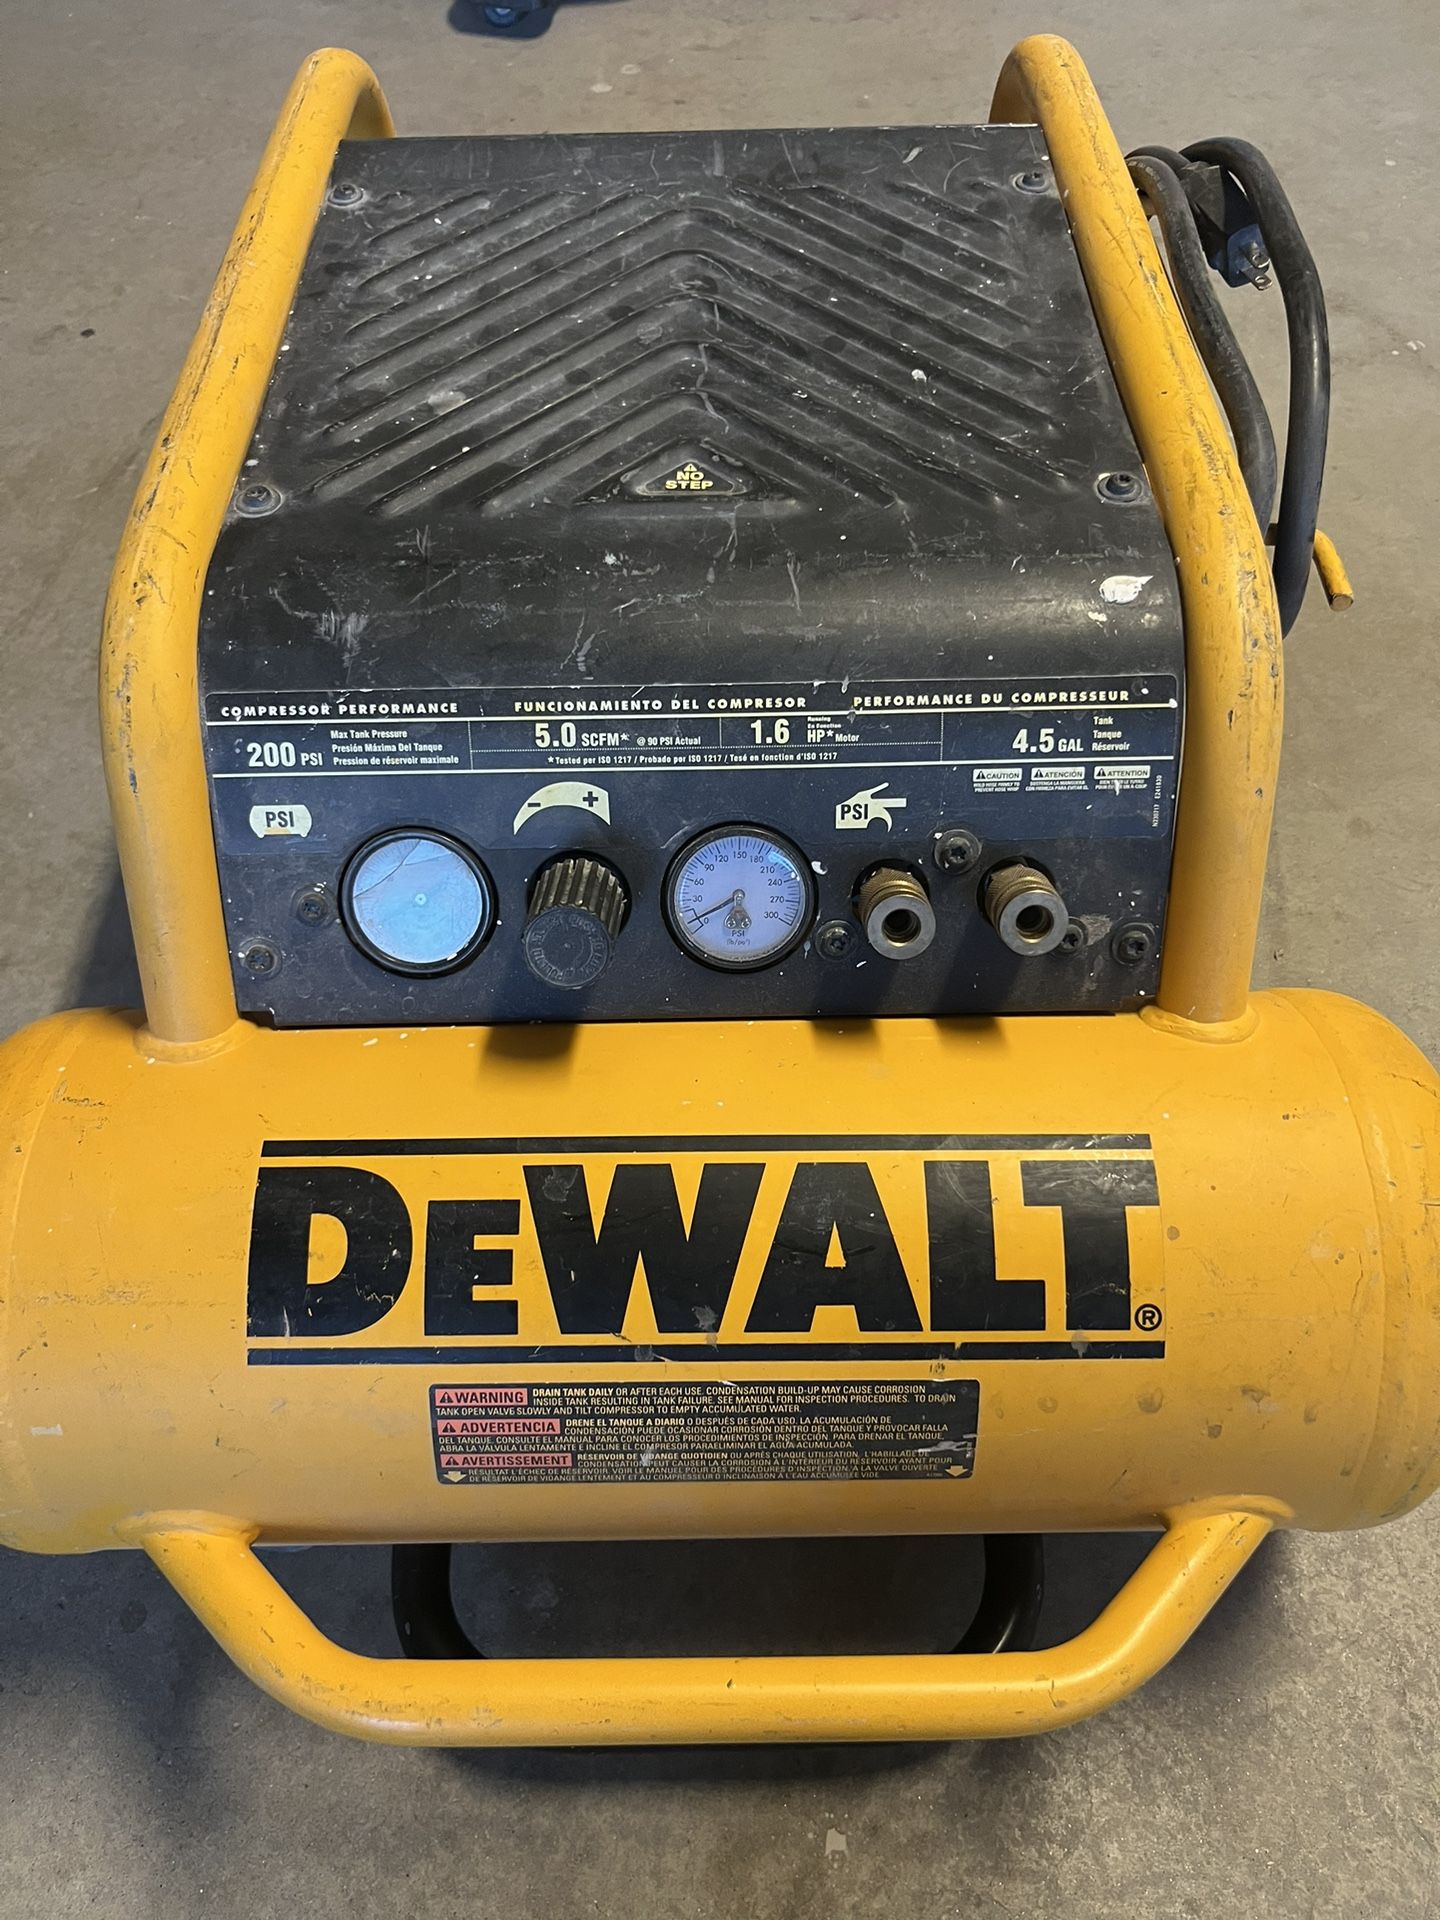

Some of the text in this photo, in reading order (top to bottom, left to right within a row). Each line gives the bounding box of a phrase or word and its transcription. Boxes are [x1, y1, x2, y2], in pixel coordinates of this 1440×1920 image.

[676, 471, 704, 481] NO
[665, 480, 713, 490] STEP
[853, 690, 1129, 707] PERFORMANCE DU COMPRESSEUR
[221, 703, 458, 717] COMPRESSOR PERFORMANCE
[514, 697, 806, 712] FUNCIONAMIENTO DEL COMPRESOR
[1093, 716, 1113, 725] Tank
[330, 730, 408, 739] Max Tank Pressure
[535, 722, 576, 748] 5.0
[647, 737, 658, 746] 90
[660, 736, 673, 745] PSI
[675, 736, 701, 745] Actual
[750, 719, 790, 744] 1.6
[1092, 730, 1122, 740] Tanque
[835, 734, 860, 742] Motor
[1012, 728, 1084, 754] 4.5 GAL
[332, 743, 443, 753] Presión Máxima Del Tanque
[1092, 742, 1130, 751] Réservoir
[247, 742, 323, 767] 200 PSI
[582, 757, 596, 766] per
[598, 756, 611, 764] ISO
[613, 756, 632, 764] 1217
[640, 755, 671, 764] Probado
[673, 756, 686, 765] por
[688, 755, 701, 763] ISO
[703, 755, 722, 763] 1217
[761, 753, 794, 761] fonction
[796, 752, 816, 760] d'ISO
[819, 752, 838, 760] 1217
[333, 755, 459, 766] Pression de réservoir maximale
[986, 772, 1019, 780] CAUTION
[1044, 770, 1082, 779] ATENCIÓN
[841, 803, 868, 820] PSI
[265, 811, 295, 828] PSI
[715, 855, 729, 863] 120
[733, 851, 747, 859] 150
[704, 864, 715, 872] 90
[760, 866, 775, 874] 210
[694, 878, 704, 886] 60
[692, 895, 703, 903] 30
[763, 911, 779, 919] 300
[245, 1160, 1160, 1338] DEWALT
[532, 1385, 926, 1397] DRAIN TANK DAILY OR AFTER EACH USE. CONDENSATION BUILD-UP MAY CAUSE CORROSION
[455, 1391, 524, 1403] WARNING
[533, 1394, 956, 1406] INSIDE TANK RESULTING IN TANK FAILURE. SEE MANUAL FOR INSPECTION PROCEDURES. TO DRAIN
[436, 1407, 460, 1416] TANK
[461, 1407, 486, 1416] OPEN
[517, 1406, 551, 1415] SLOWLY
[553, 1406, 573, 1415] AND
[575, 1406, 592, 1415] TILT
[594, 1406, 655, 1415] COMPRESSOR
[657, 1405, 668, 1414] TO
[670, 1405, 700, 1414] EMPTY
[702, 1405, 767, 1414] ACCUMULATED
[769, 1404, 802, 1413] WATER.
[565, 1414, 891, 1427] DRENE EL TANQUE A DIARIO O DESPUÉS DE CADA USO. LA ACUMULACIÓN DE
[460, 1421, 556, 1433] ADVERTENCIA
[637, 1426, 664, 1435] PUEDE
[667, 1426, 719, 1435] OCASIONAR
[774, 1425, 809, 1433] DENTRO
[811, 1425, 827, 1433] DEL
[830, 1425, 864, 1433] TANQUE
[866, 1424, 871, 1433] Y
[873, 1424, 921, 1432] PROVOCAR
[922, 1424, 948, 1432] FALLA
[439, 1436, 456, 1444] DEL
[496, 1436, 541, 1444] CONSULTE
[542, 1435, 553, 1443] EL
[555, 1435, 593, 1443] MANUAL
[595, 1435, 619, 1443] PARA
[620, 1435, 662, 1443] CONOCER
[664, 1434, 680, 1442] LOS
[683, 1434, 760, 1442] PROCEDIMIENTOS
[762, 1434, 773, 1442] DE
[833, 1433, 856, 1441] PARA
[858, 1433, 894, 1441] DRENAR
[896, 1432, 906, 1440] EL
[461, 1455, 568, 1466] AVERTISSEMENT
